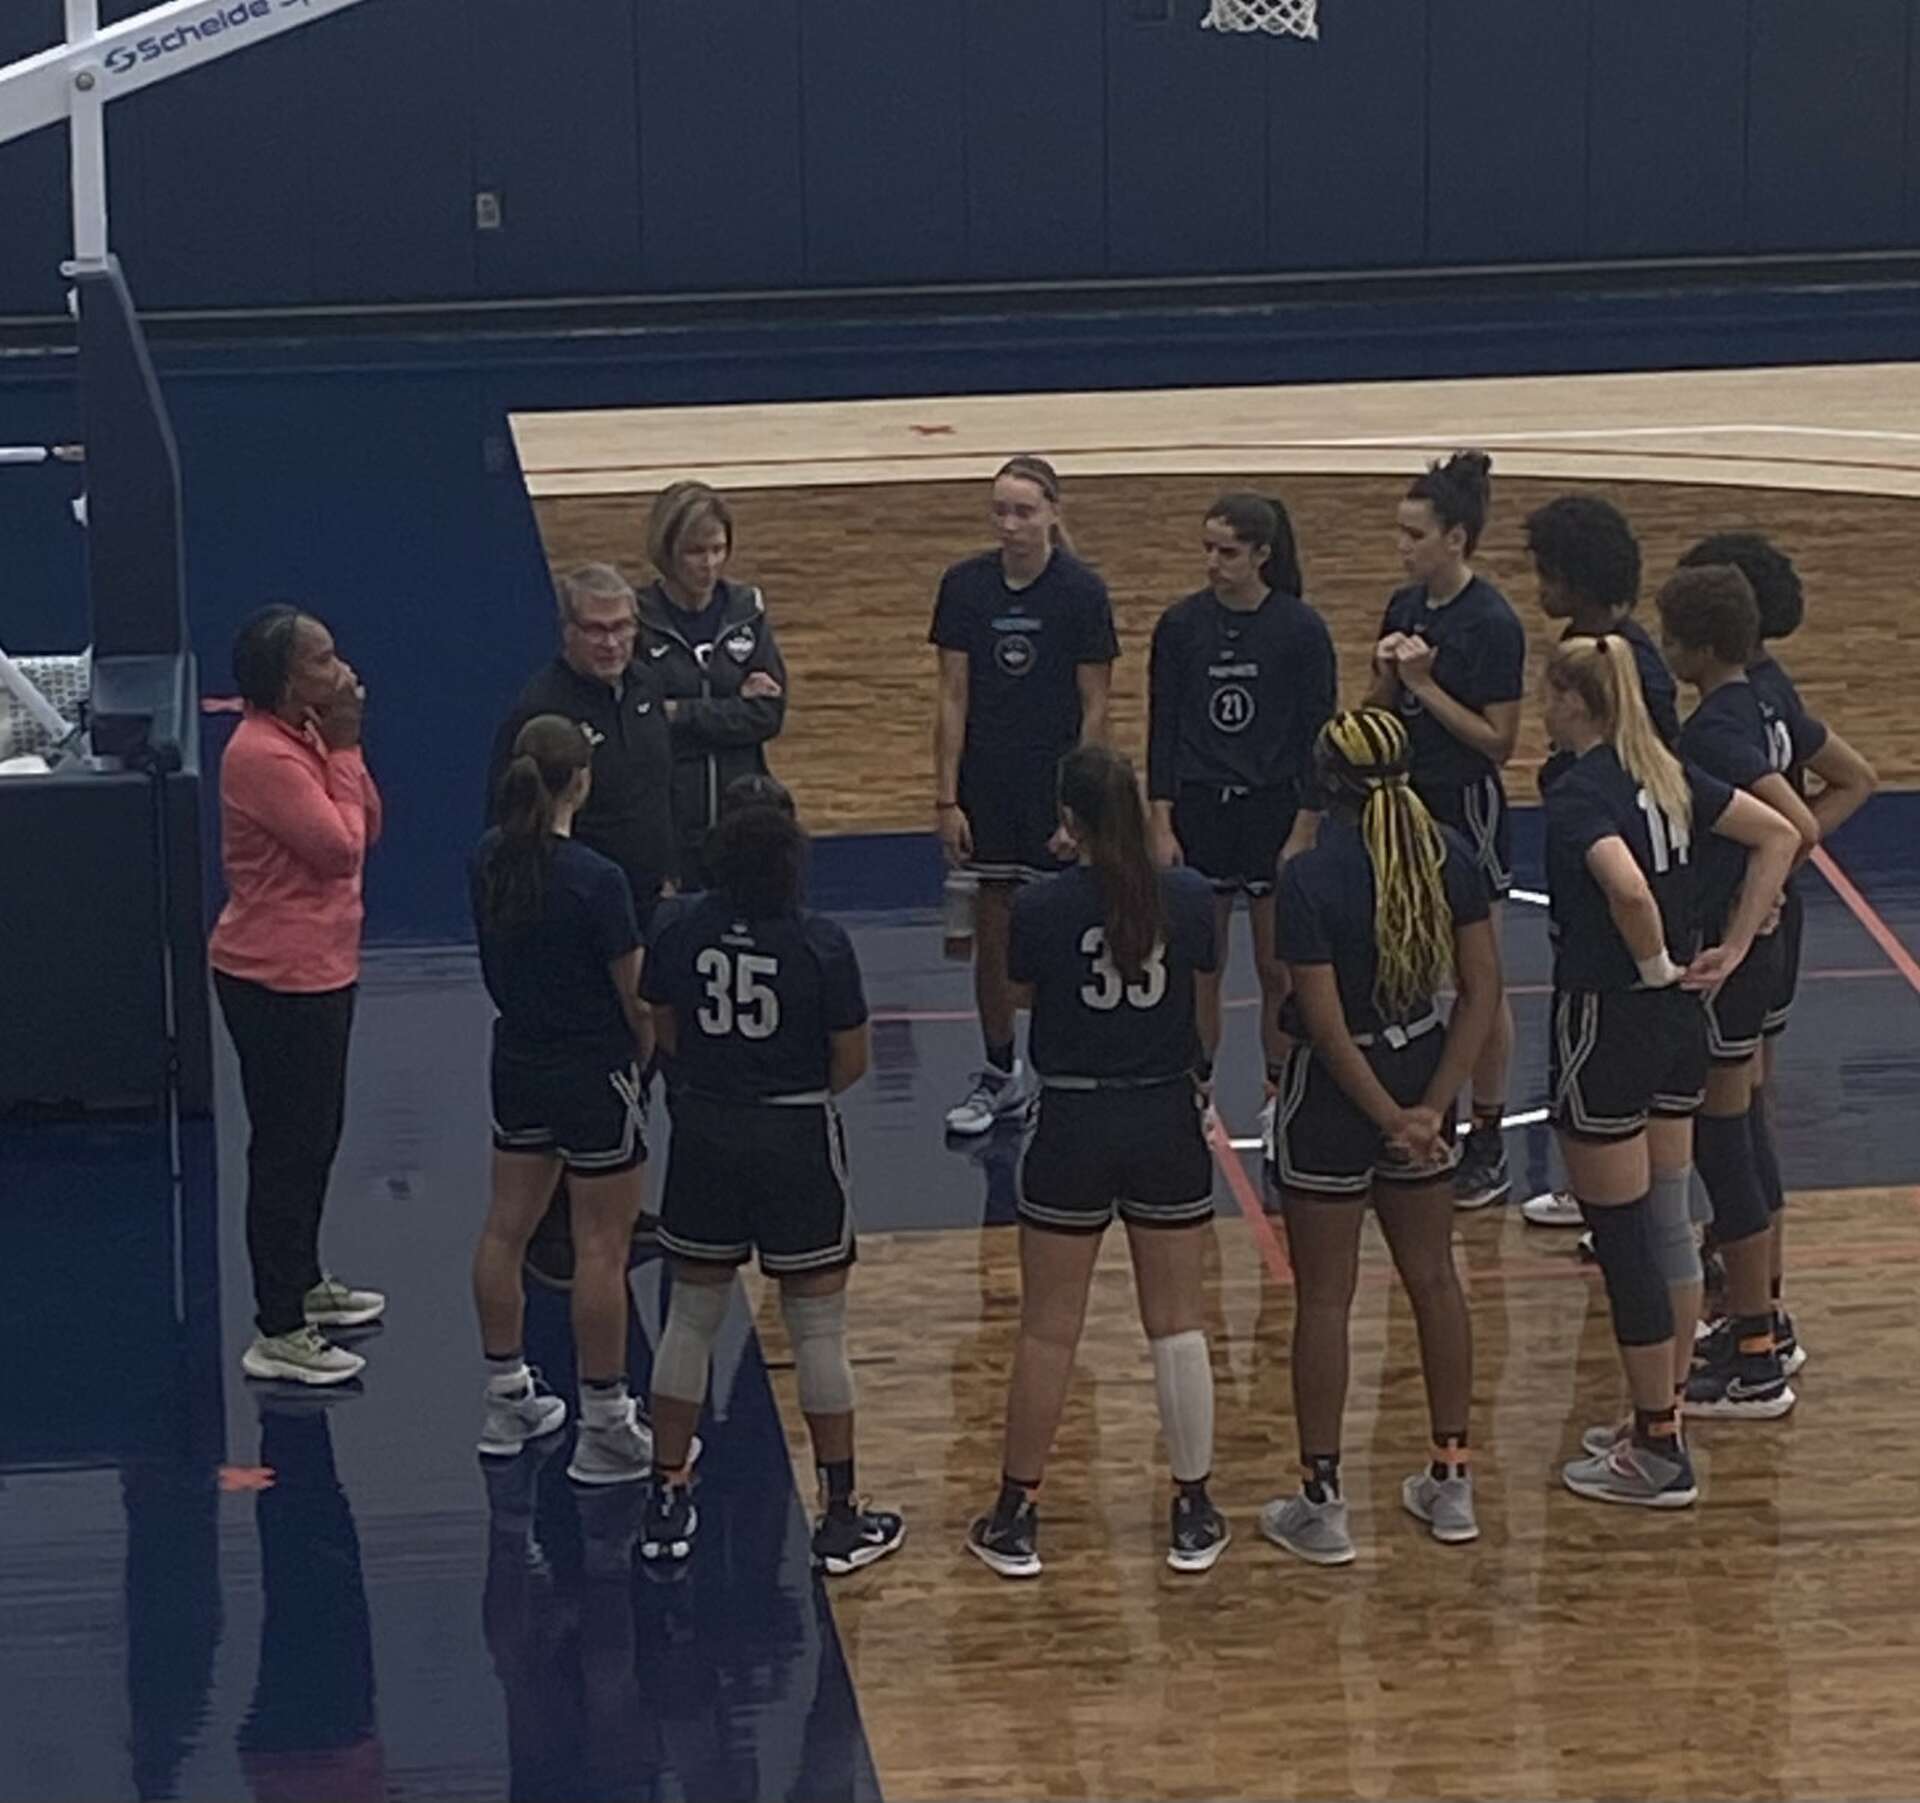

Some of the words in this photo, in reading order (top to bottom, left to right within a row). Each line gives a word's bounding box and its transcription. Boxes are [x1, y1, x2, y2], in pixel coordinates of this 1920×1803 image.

[136, 0, 270, 62] Schelde
[1221, 693, 1243, 721] 21
[696, 947, 778, 1039] 35
